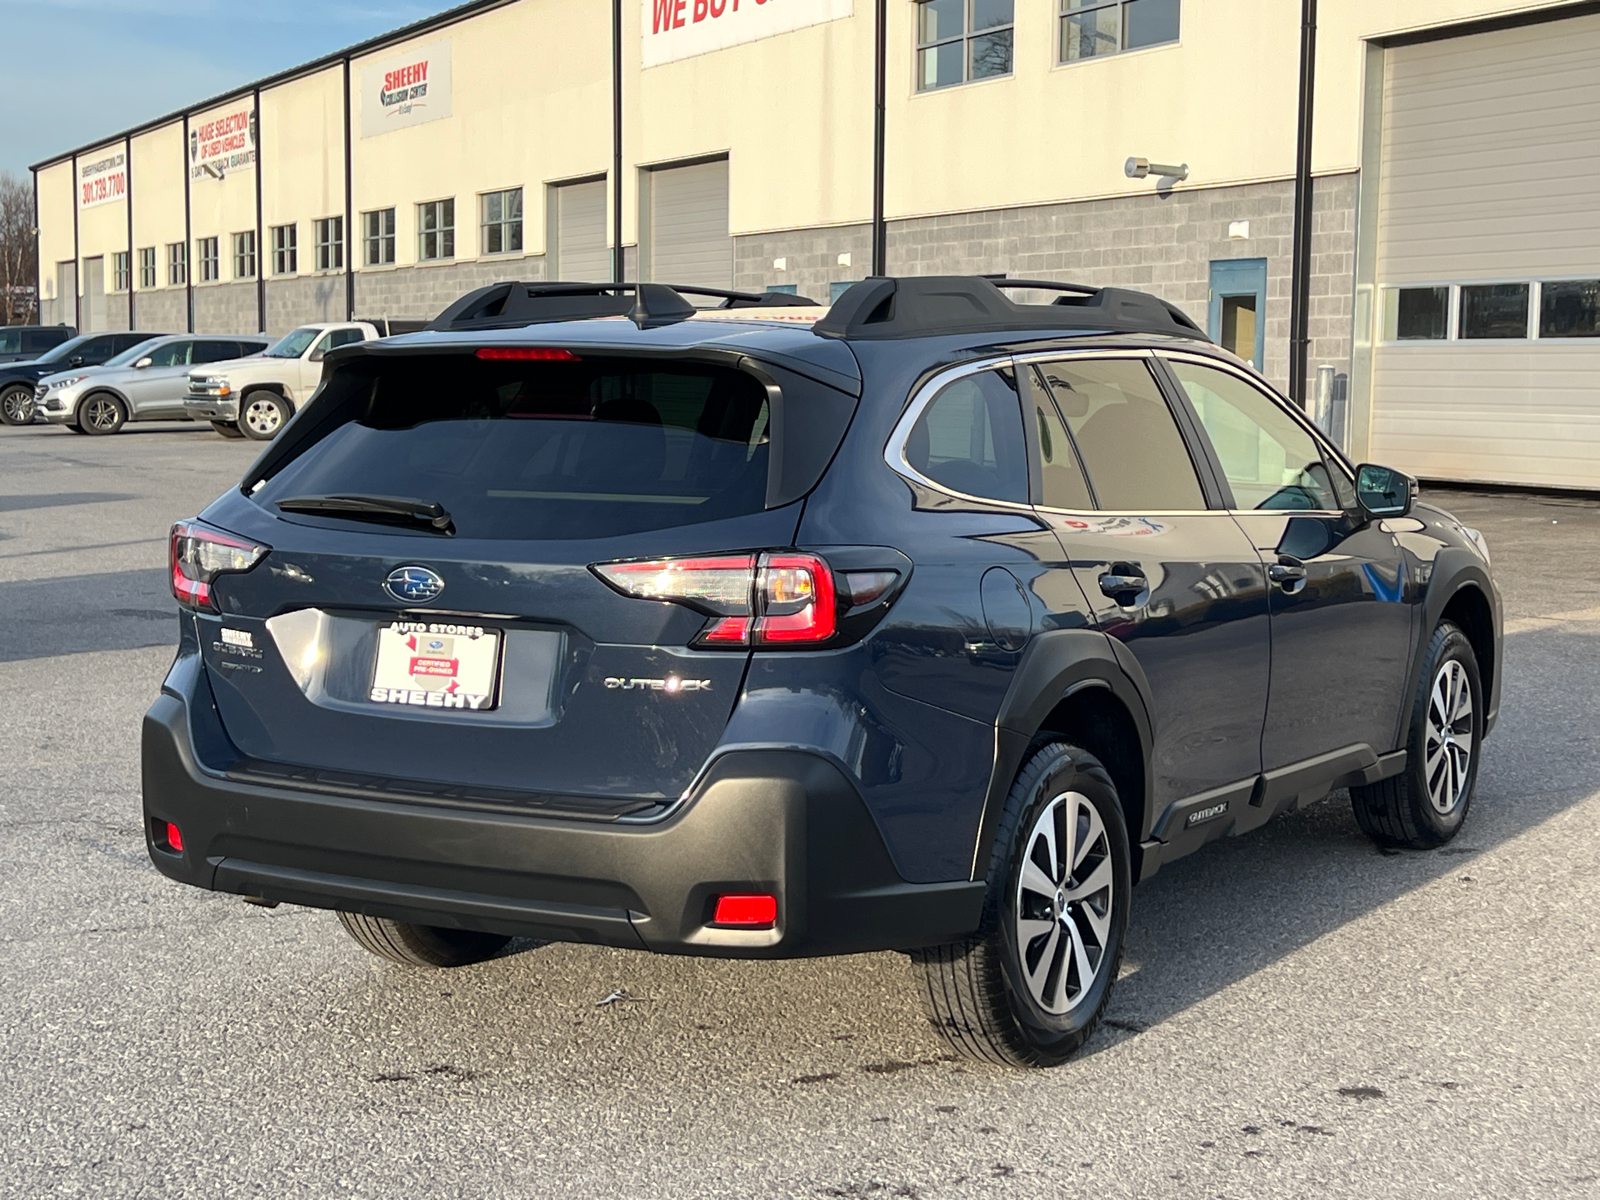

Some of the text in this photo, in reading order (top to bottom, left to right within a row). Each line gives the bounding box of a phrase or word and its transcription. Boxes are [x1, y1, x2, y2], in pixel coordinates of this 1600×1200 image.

[385, 60, 428, 91] SHEEHY
[199, 111, 247, 144] HUGE SELECTION
[201, 132, 245, 160] OF USED VEHICLES
[82, 171, 124, 205] 301.739.7700
[390, 621, 484, 637] AUTO STORES
[413, 665, 454, 675] PRE-OWNED
[417, 659, 451, 668] CERTIFIED
[603, 677, 714, 691] OUTBCK
[370, 687, 486, 709] SHEEHY
[1189, 802, 1227, 823] OUTBACK
